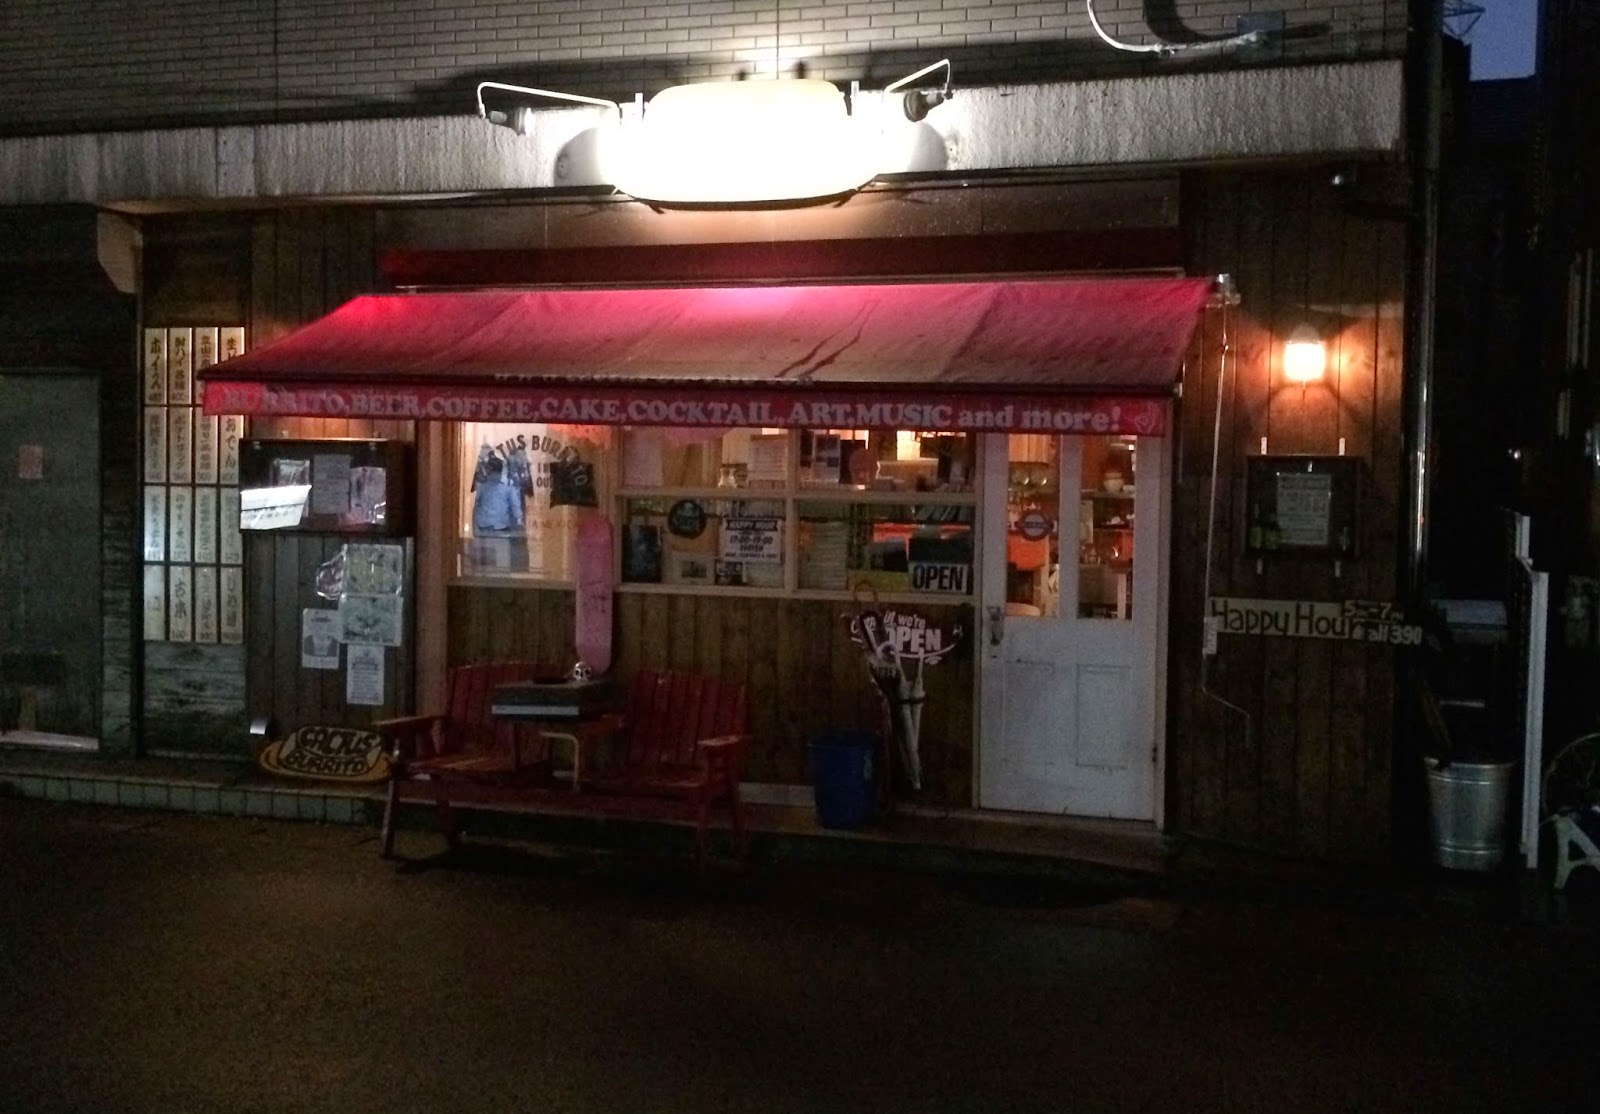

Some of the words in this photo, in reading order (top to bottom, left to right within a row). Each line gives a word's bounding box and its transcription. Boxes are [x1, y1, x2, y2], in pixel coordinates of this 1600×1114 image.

[957, 405, 1014, 428] and
[1021, 406, 1121, 431] more!
[912, 565, 963, 591] OPEN
[1211, 600, 1289, 635] Happy
[1295, 602, 1364, 637] Hour
